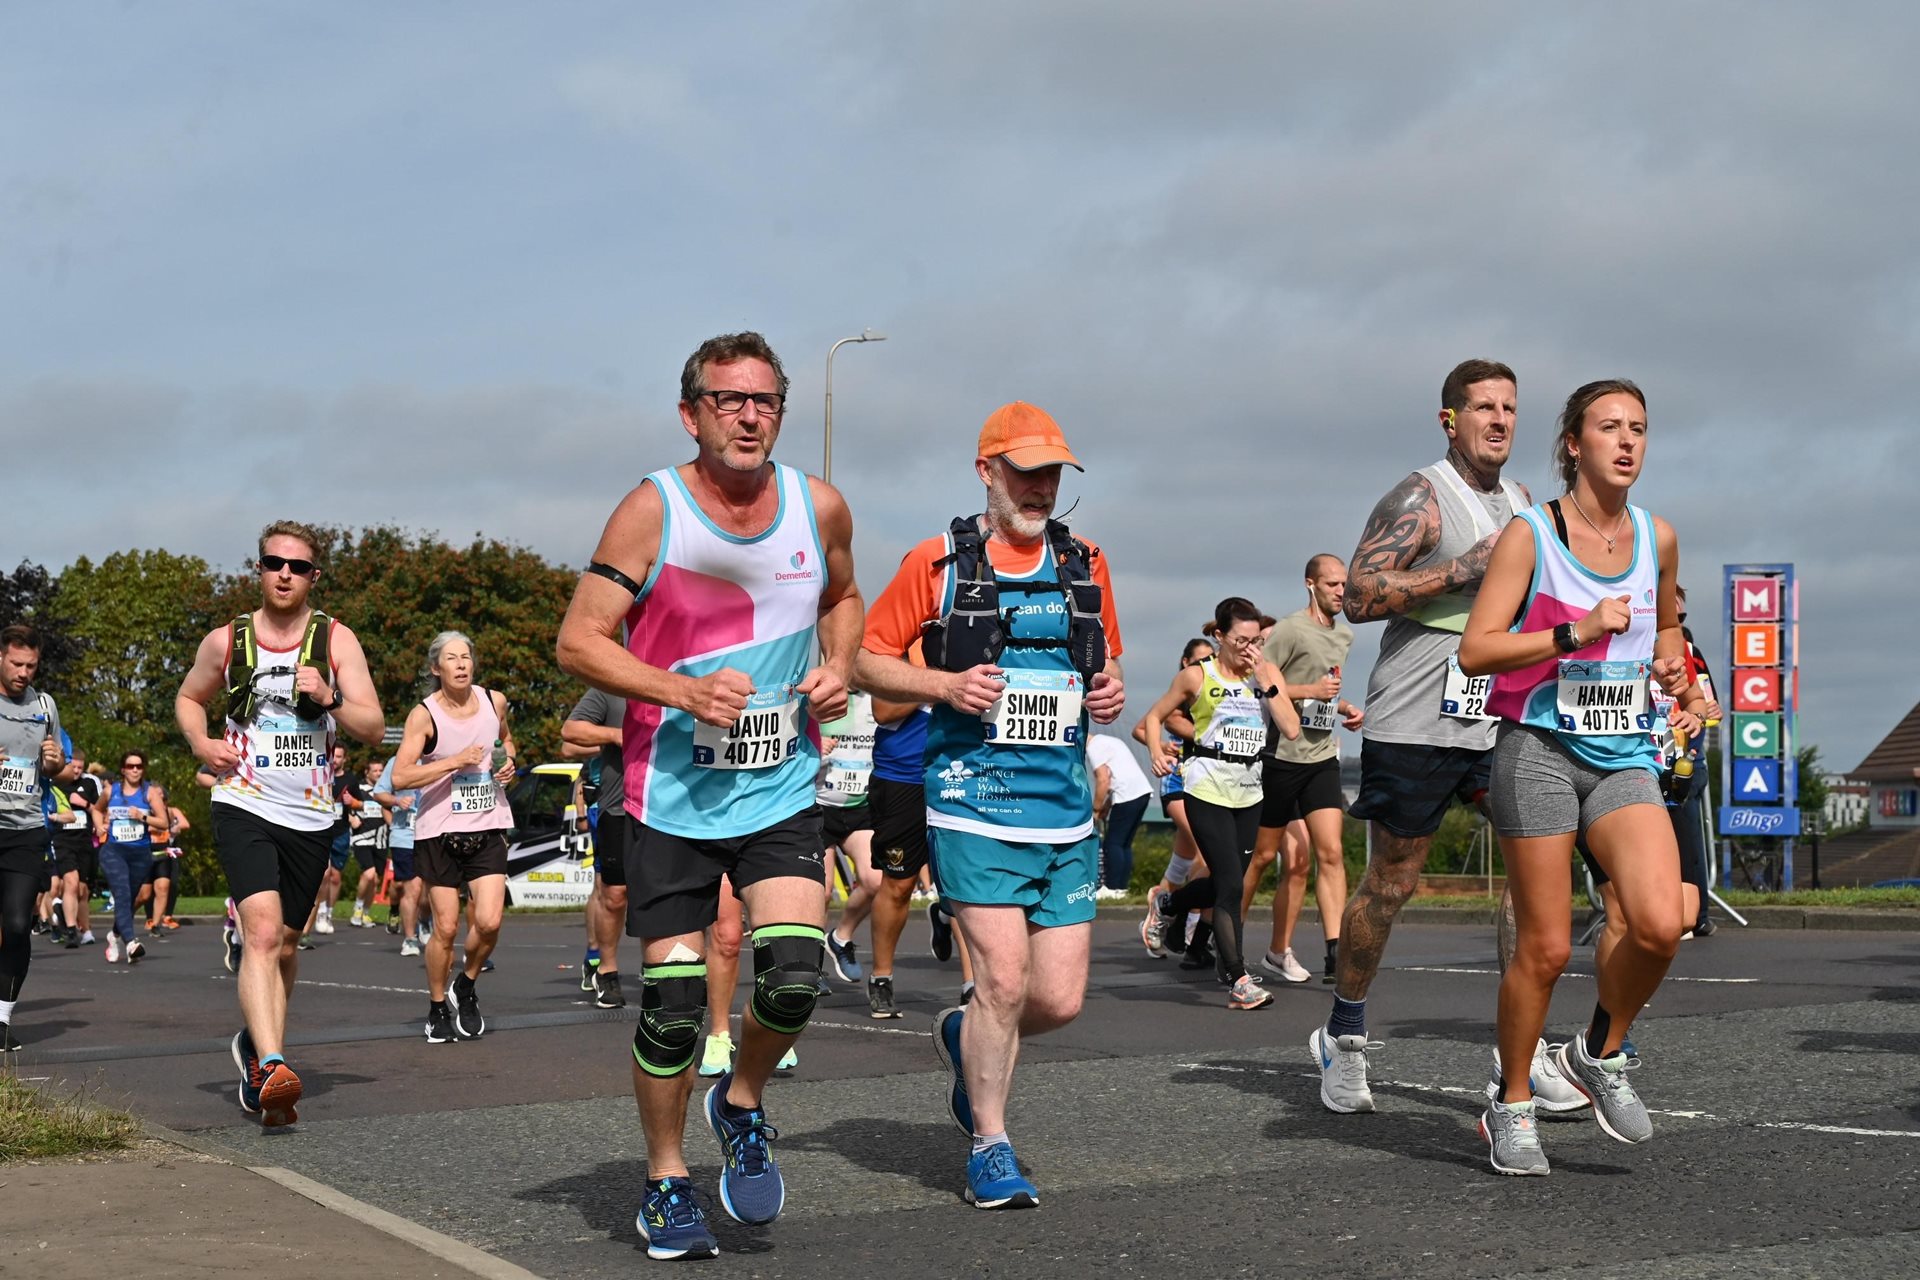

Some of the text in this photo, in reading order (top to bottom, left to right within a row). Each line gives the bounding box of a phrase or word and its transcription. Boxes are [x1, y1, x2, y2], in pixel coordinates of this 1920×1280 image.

[1019, 604, 1041, 615] can
[1577, 685, 1634, 706] HANNAH
[1743, 587, 1769, 792] MECCA
[1007, 693, 1058, 717] SIMON
[729, 712, 779, 738] DAVID
[1582, 709, 1630, 731] 40775
[1006, 718, 1058, 741] 21818
[1222, 727, 1263, 742] MICHELLE
[274, 735, 314, 750] DANIEL
[1228, 741, 1256, 754] 31172
[724, 738, 781, 765] 40779
[275, 752, 313, 767] 28534
[2, 768, 24, 780] DEAN
[844, 772, 857, 781] IAN
[837, 781, 862, 792] 37577
[977, 783, 1011, 794] WALES
[466, 796, 492, 810] 25722
[1730, 809, 1783, 833] Bingo
